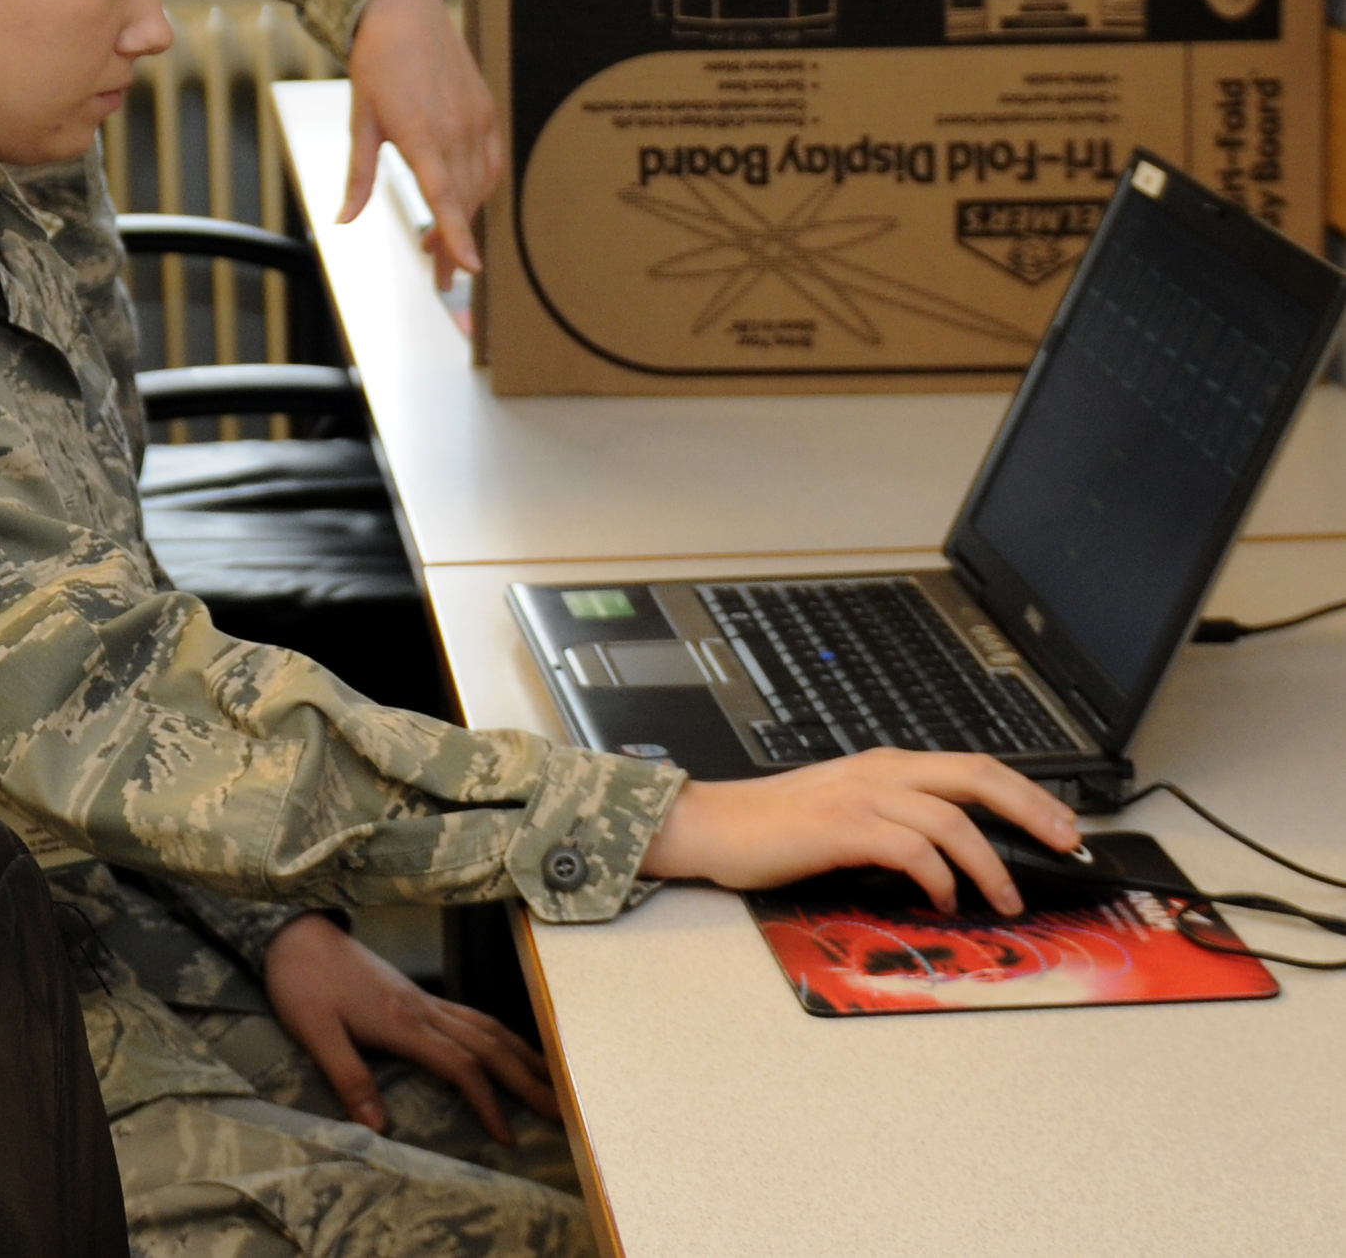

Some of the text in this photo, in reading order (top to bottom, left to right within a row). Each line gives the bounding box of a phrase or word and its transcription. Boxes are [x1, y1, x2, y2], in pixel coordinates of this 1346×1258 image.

[639, 136, 1116, 186] Tri-Fold Display Board
[964, 204, 1101, 231] ELMER'S
